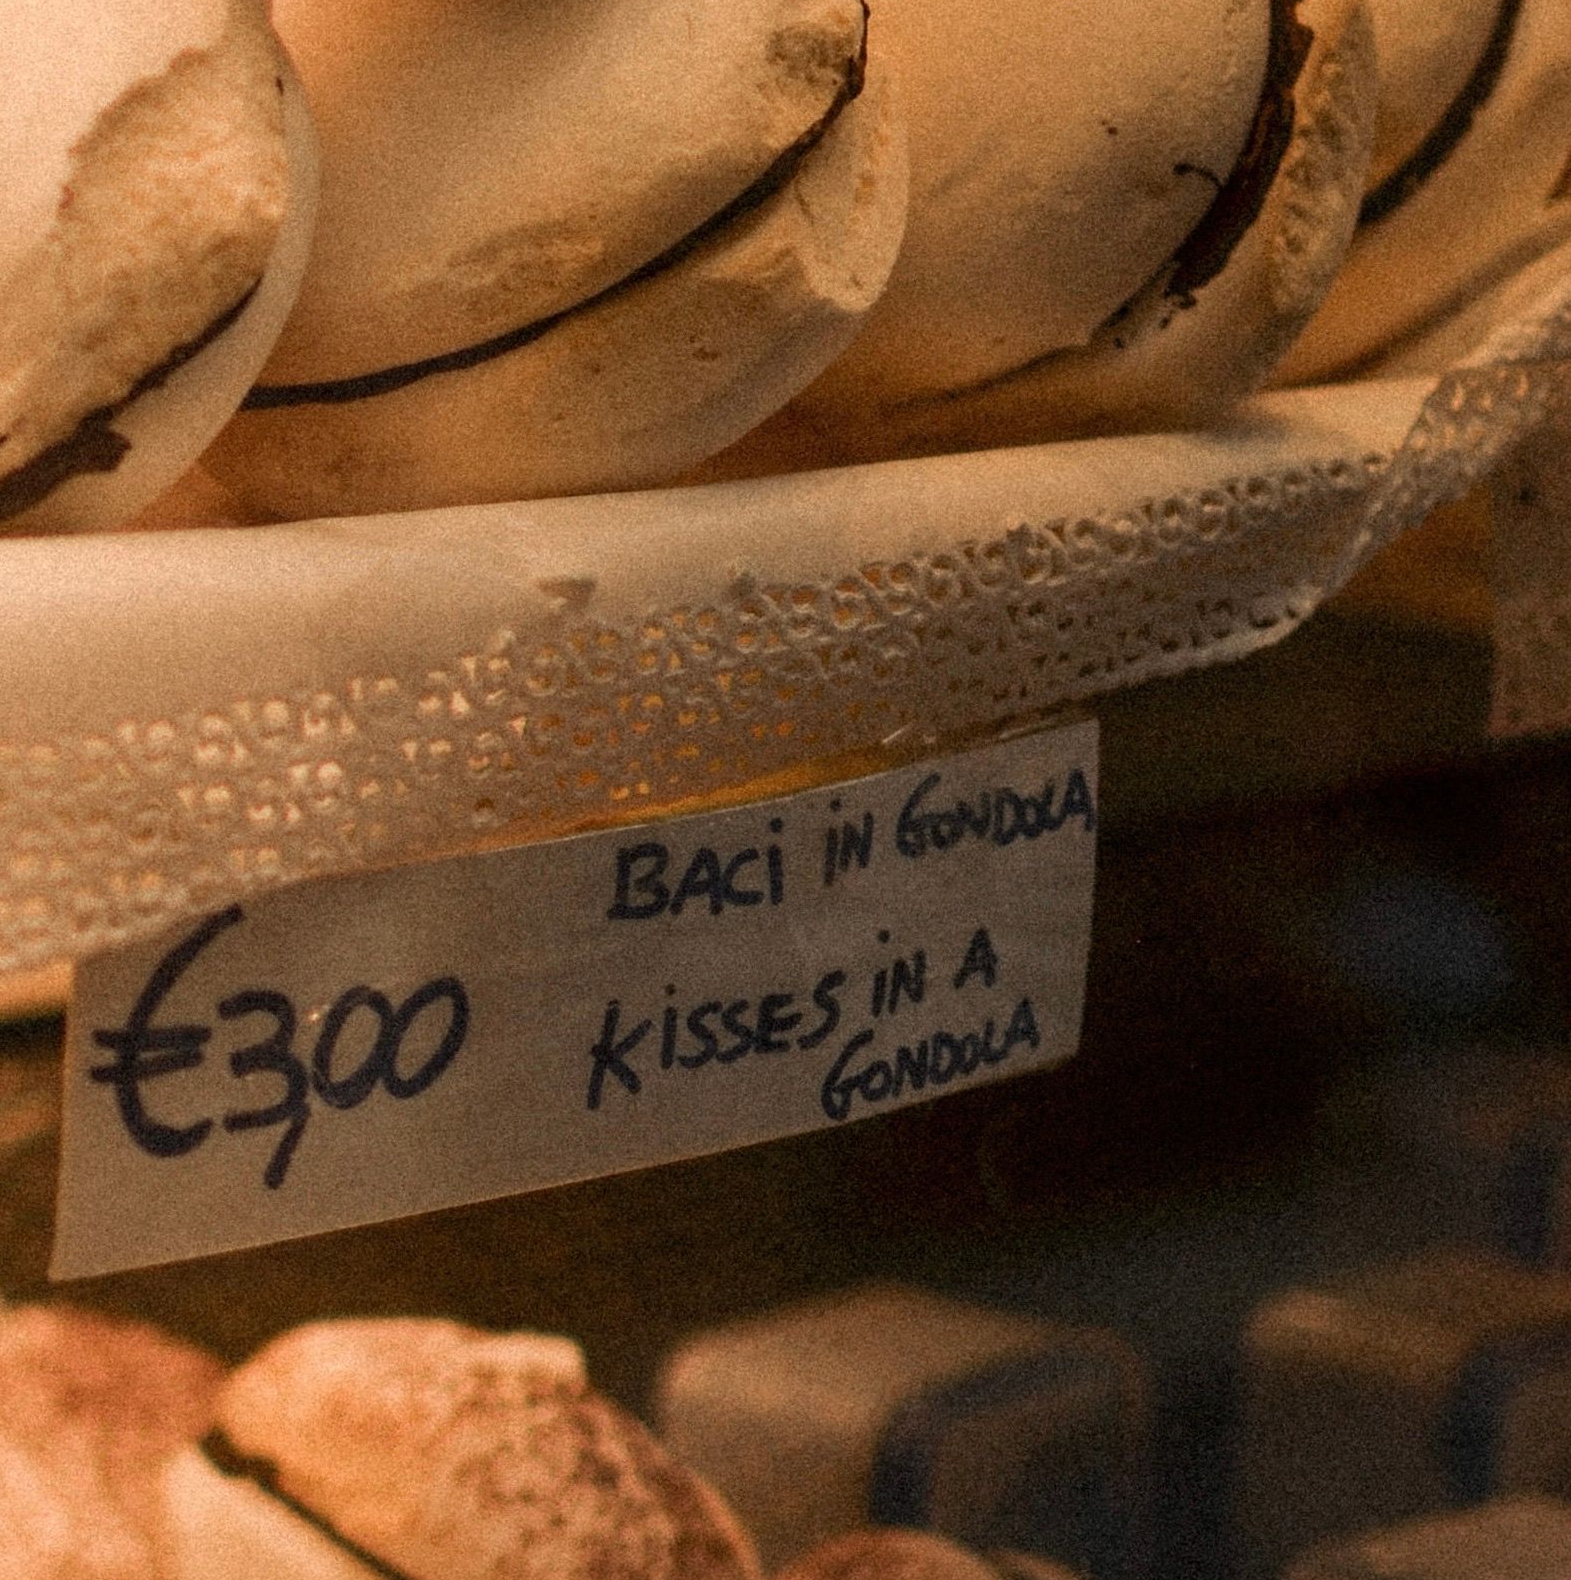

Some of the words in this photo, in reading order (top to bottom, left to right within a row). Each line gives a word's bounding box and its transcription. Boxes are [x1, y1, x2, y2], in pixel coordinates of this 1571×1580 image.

[895, 769, 1096, 859] GONDOLA
[954, 926, 1001, 988] A
[818, 997, 1042, 1122] GONDOLA
